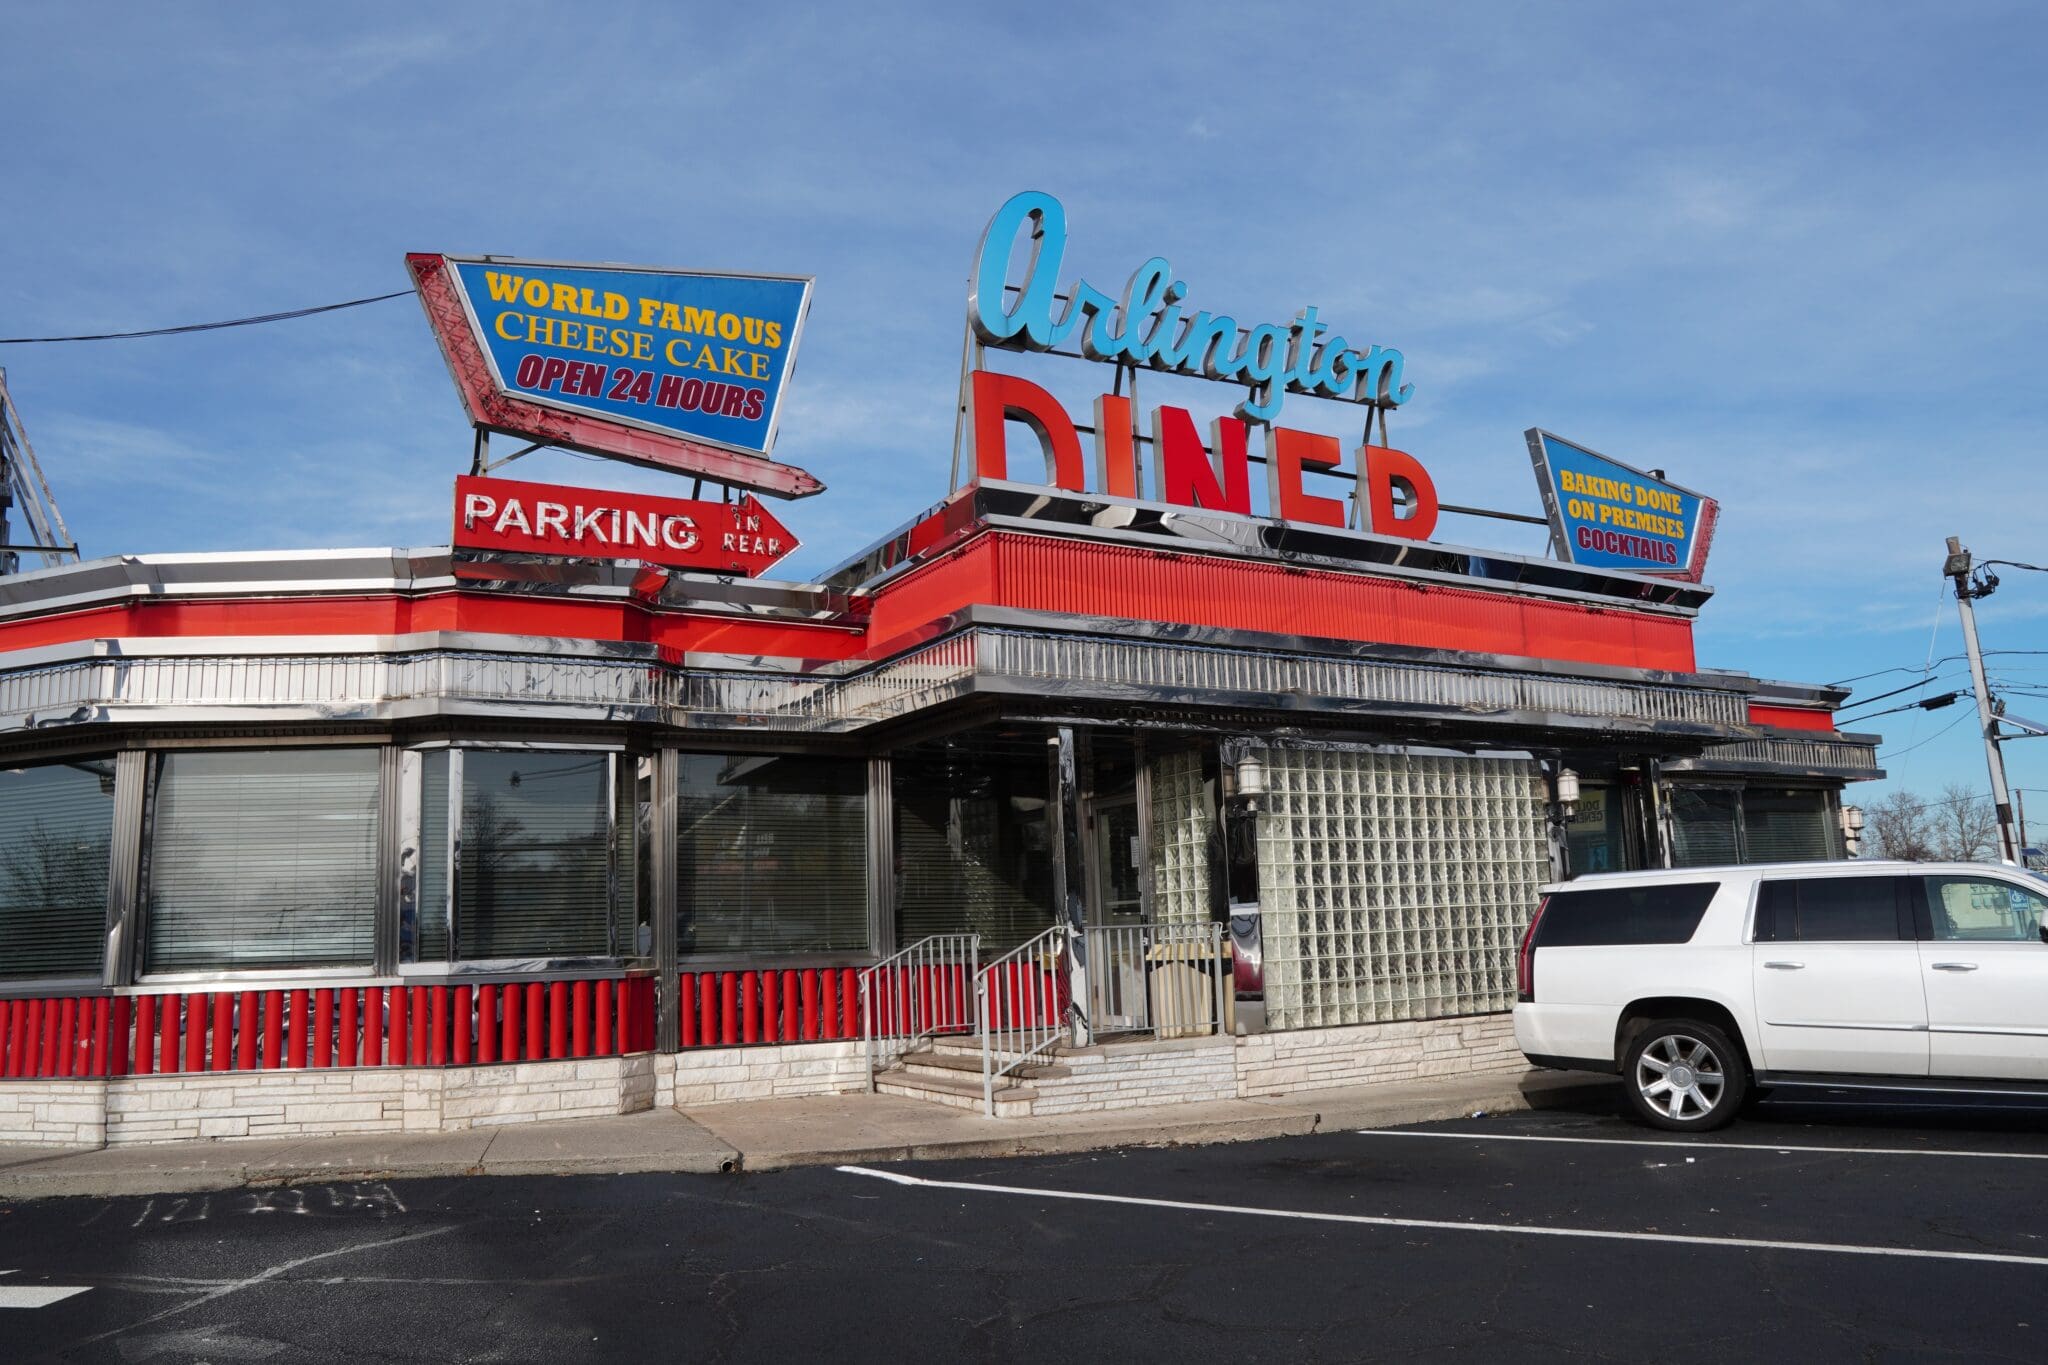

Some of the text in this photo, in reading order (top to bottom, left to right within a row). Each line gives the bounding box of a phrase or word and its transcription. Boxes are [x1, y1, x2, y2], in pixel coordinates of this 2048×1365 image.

[485, 271, 782, 350] WORLD FAMOUS
[969, 190, 1415, 422] Arlington
[495, 311, 770, 382] CHEESE CAKE
[516, 354, 766, 421] OPEN 24 HOURS
[1560, 469, 1682, 515] BAKING DONE
[464, 494, 699, 550] PARKING
[723, 533, 780, 556] REAR
[734, 513, 760, 532] IN
[1567, 499, 1685, 540] ON PREMISES
[1577, 526, 1677, 565] COCKTAILS
